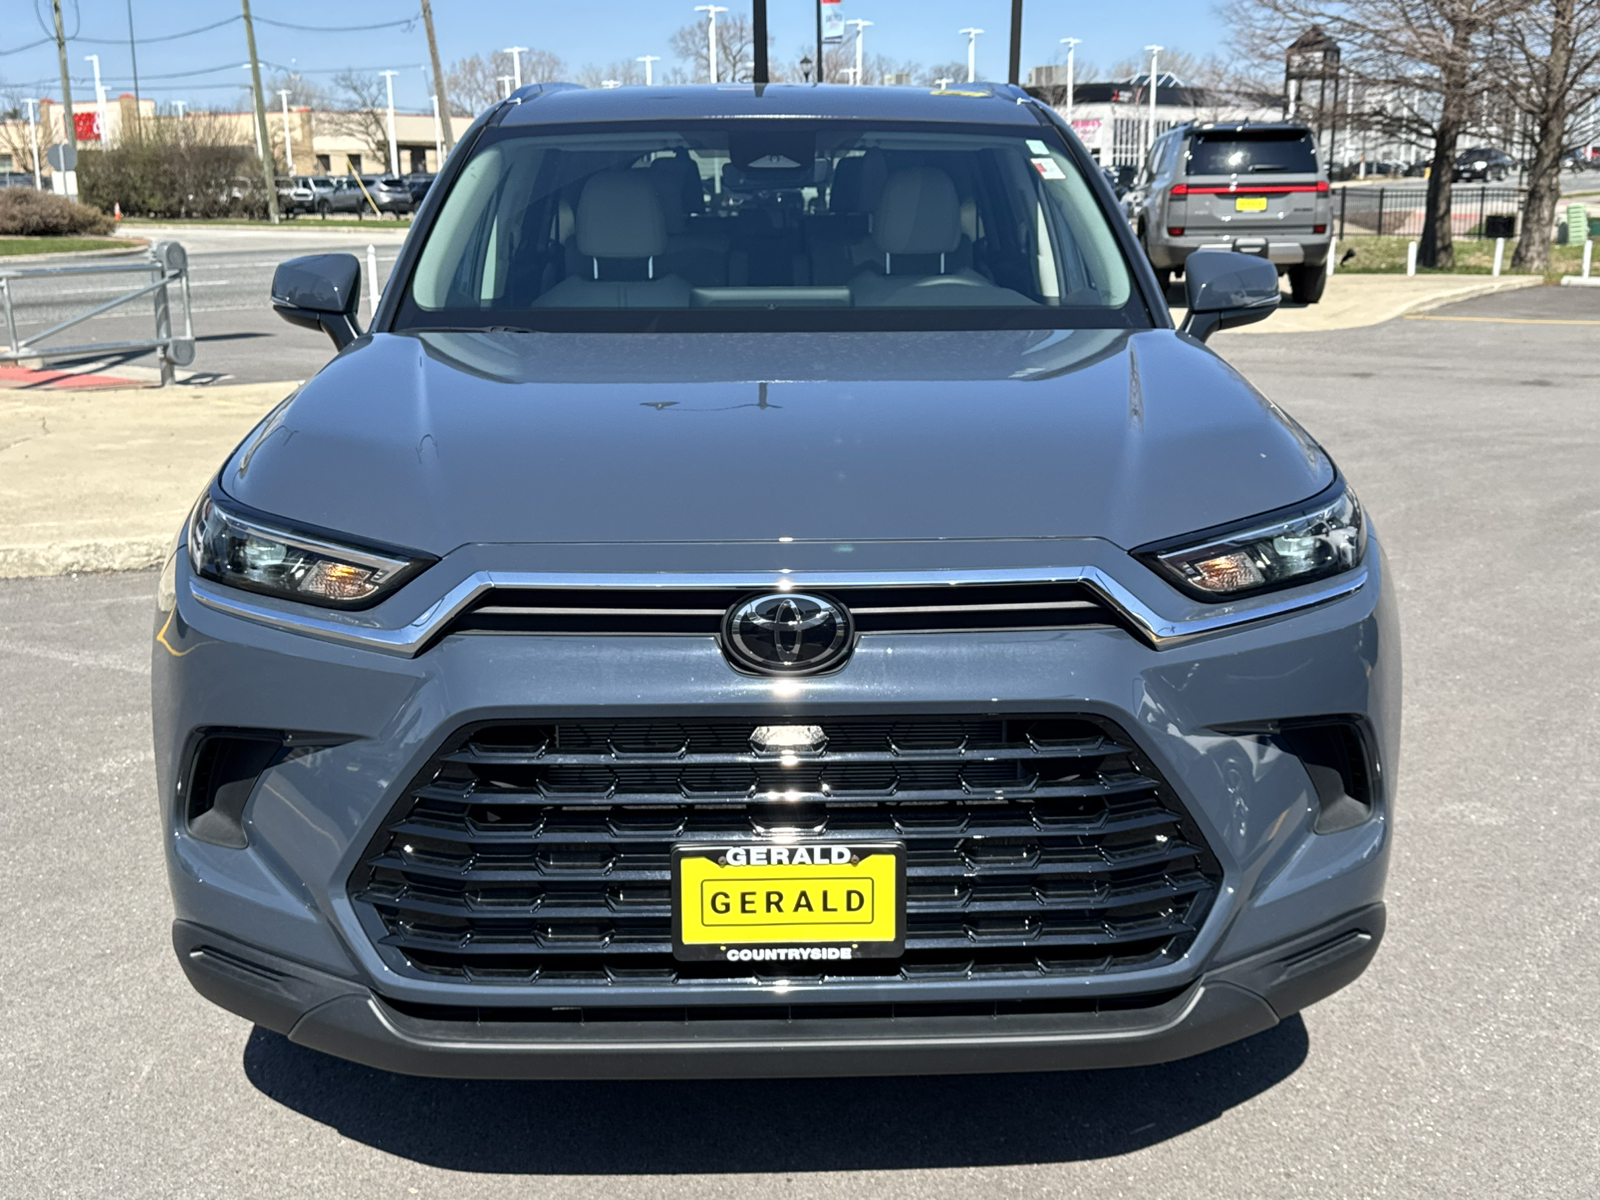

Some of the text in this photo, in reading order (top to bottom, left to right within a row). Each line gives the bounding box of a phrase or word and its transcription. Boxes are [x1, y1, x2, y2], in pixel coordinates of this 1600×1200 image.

[725, 846, 851, 866] GERALD
[710, 889, 865, 914] GERALD
[726, 947, 852, 962] COUNTRYSIDE
